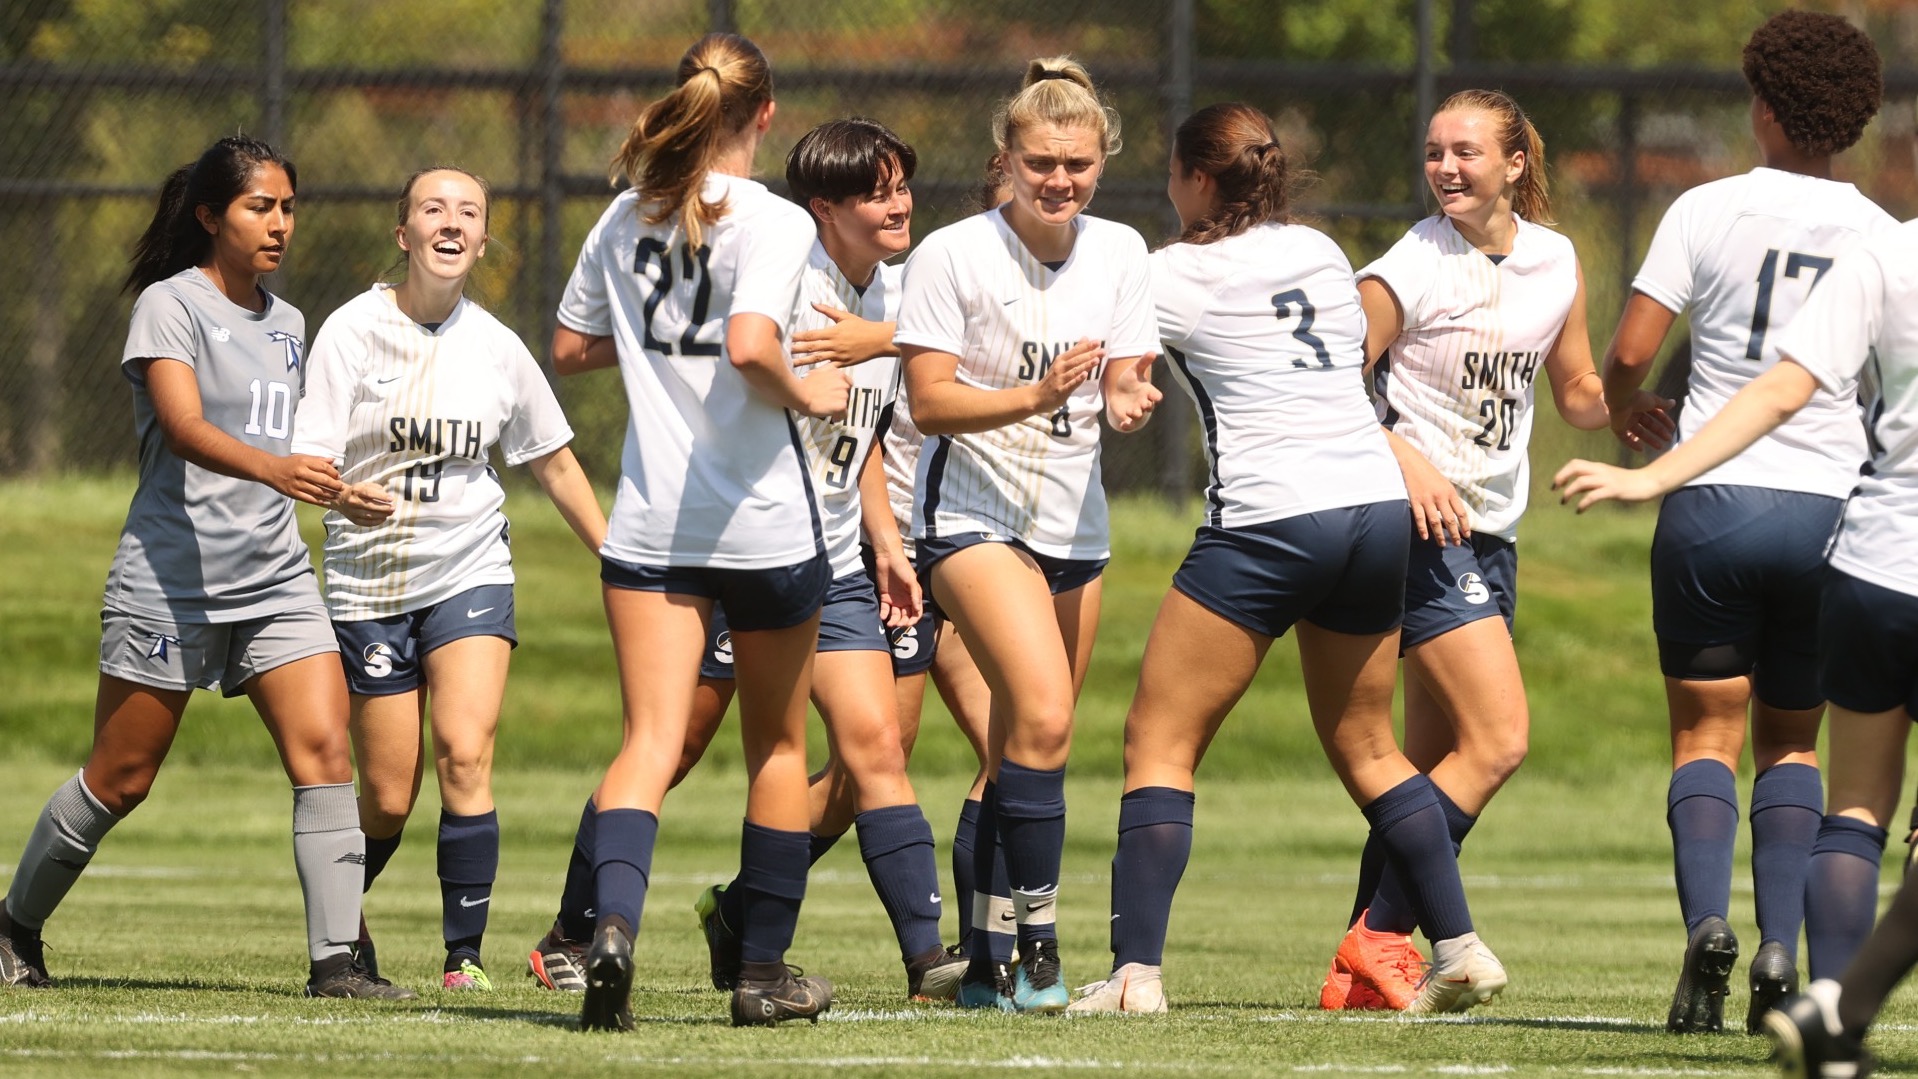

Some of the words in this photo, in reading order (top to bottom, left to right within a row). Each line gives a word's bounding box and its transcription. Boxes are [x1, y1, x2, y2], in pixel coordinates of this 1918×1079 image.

[634, 238, 721, 356] 22
[1745, 249, 1834, 361] 17
[1271, 288, 1334, 370] 3
[1462, 352, 1538, 390] SMITH
[244, 378, 290, 440] 10
[1474, 398, 1516, 450] 20
[390, 417, 481, 459] SMITH
[826, 435, 858, 489] 9
[404, 460, 442, 502] 19
[364, 643, 392, 677] S
